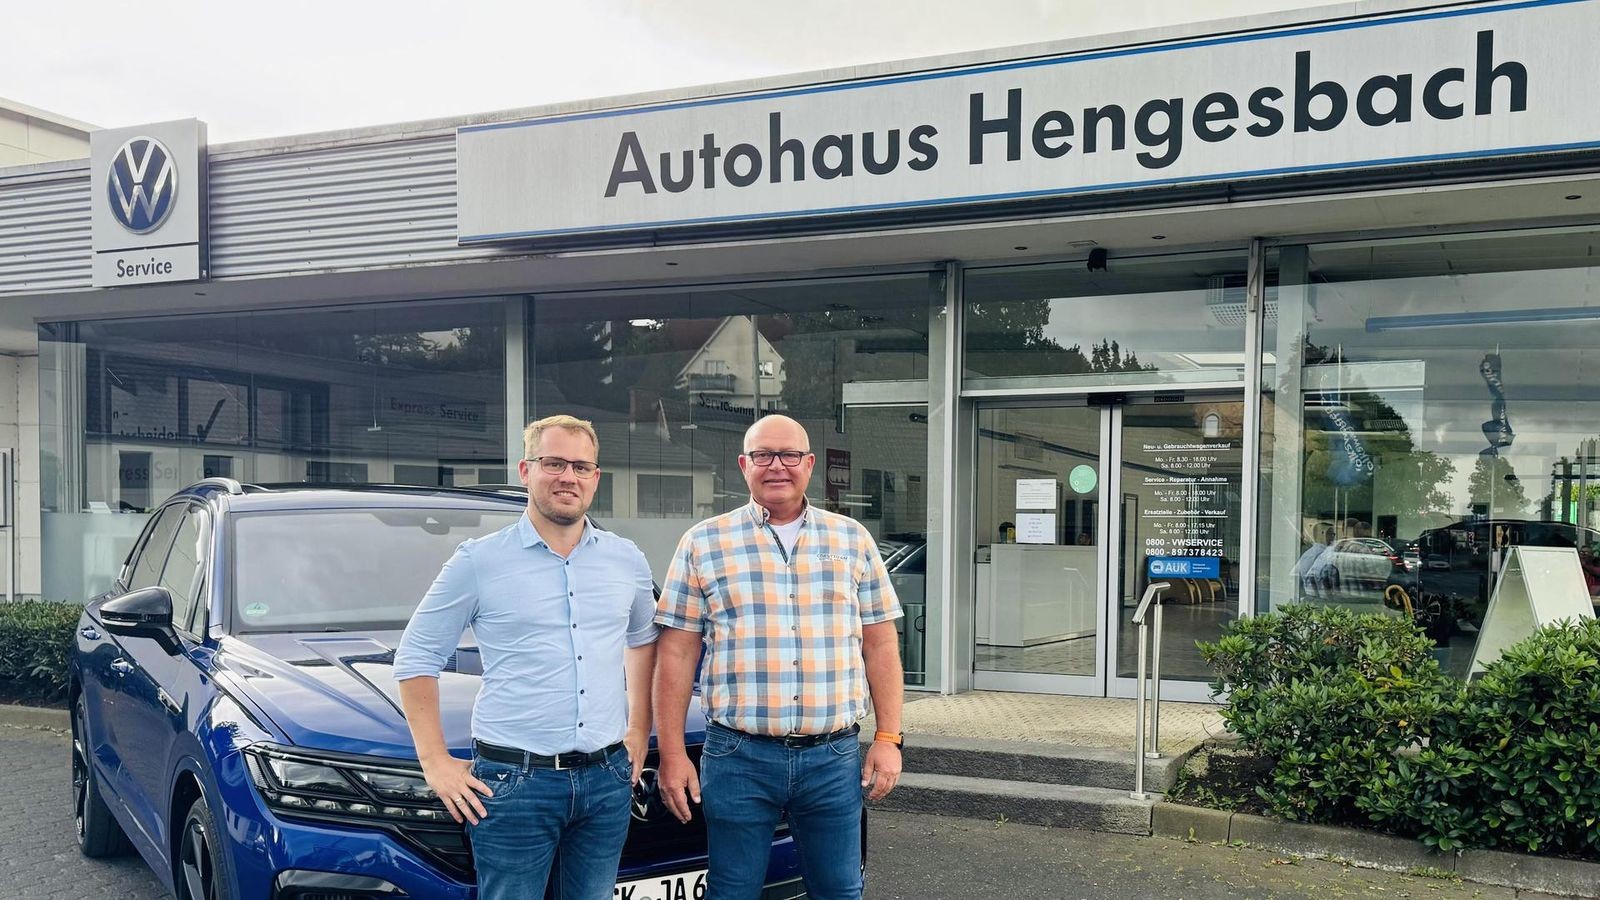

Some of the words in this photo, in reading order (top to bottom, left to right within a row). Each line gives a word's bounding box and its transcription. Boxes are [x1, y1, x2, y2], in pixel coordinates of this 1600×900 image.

[604, 112, 939, 198] Autohaus
[968, 30, 1528, 170] Hengesbach
[116, 257, 173, 278] Service
[1145, 539, 1165, 547] 0800
[1172, 539, 1223, 547] VWSERVICE
[1145, 548, 1165, 557] 0800
[1171, 548, 1224, 557] 897378423
[661, 878, 686, 900] JA
